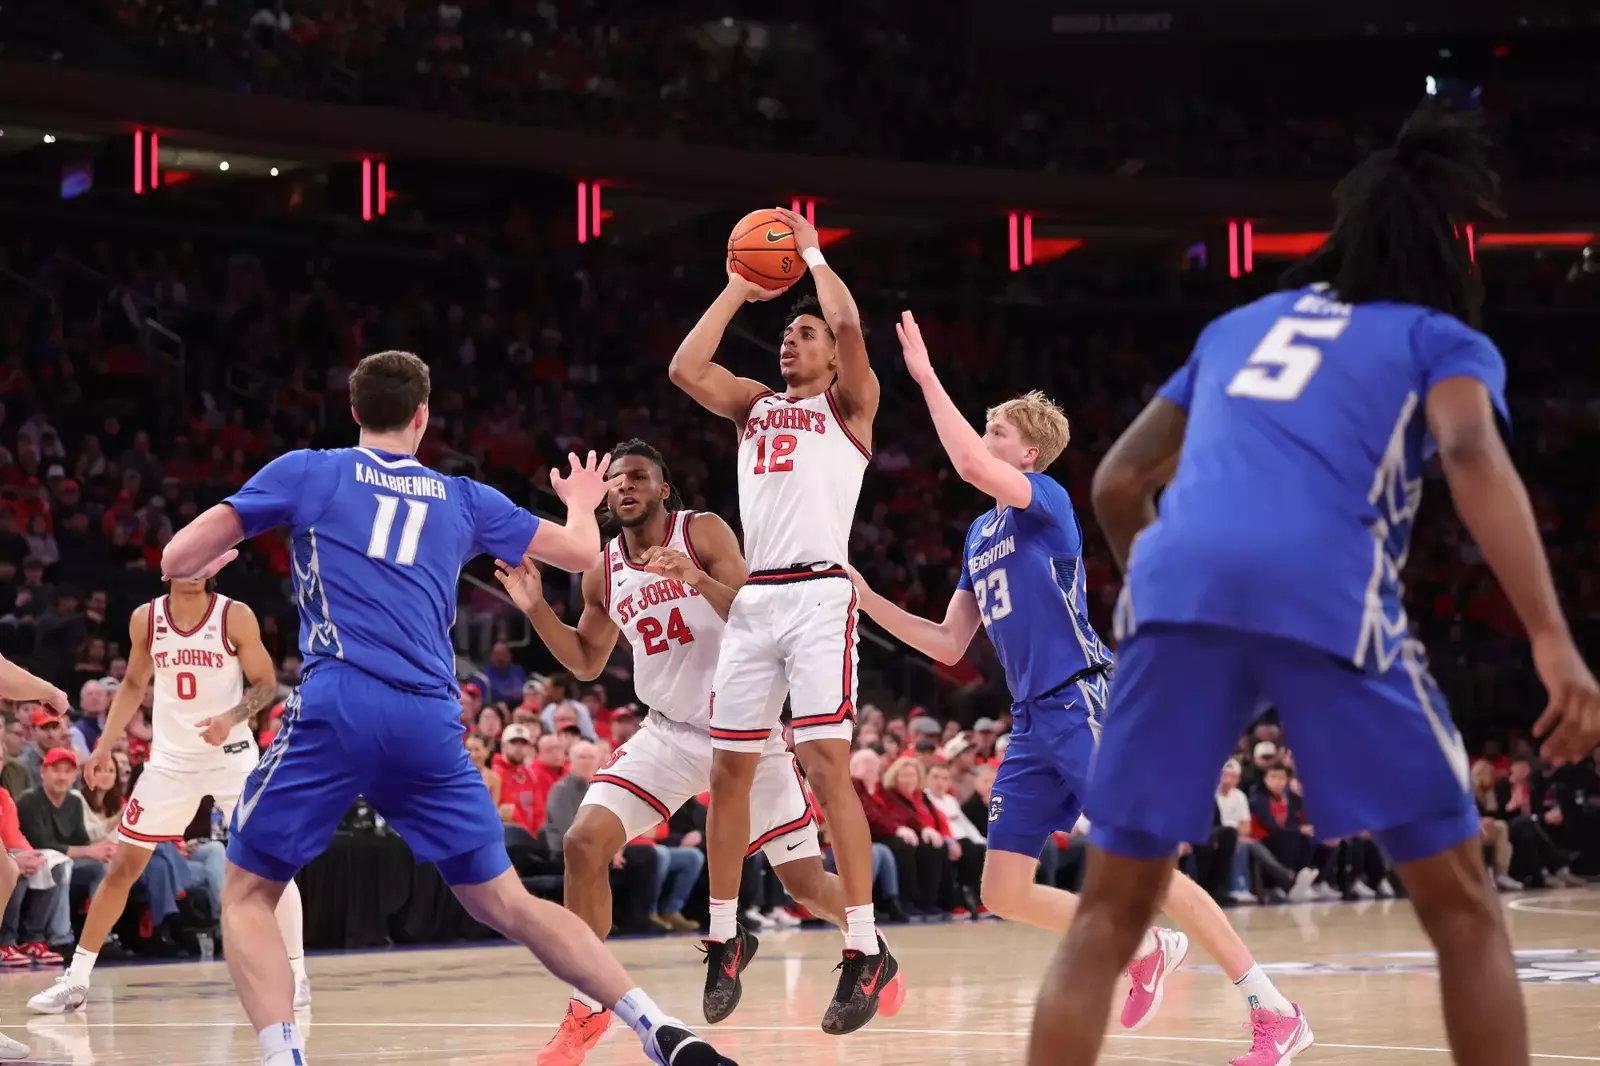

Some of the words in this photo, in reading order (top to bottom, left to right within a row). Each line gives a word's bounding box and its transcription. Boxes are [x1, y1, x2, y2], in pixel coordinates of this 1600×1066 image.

[1225, 315, 1350, 401] 5
[760, 407, 826, 435] JOHN'S
[753, 434, 798, 475] 12
[355, 461, 447, 501] KALKBRENNER
[366, 493, 430, 568] 11
[973, 567, 1013, 629] 23
[636, 606, 695, 656] 24
[154, 651, 170, 669] ST.
[171, 648, 224, 669] JOHN'S
[176, 671, 197, 700] 0
